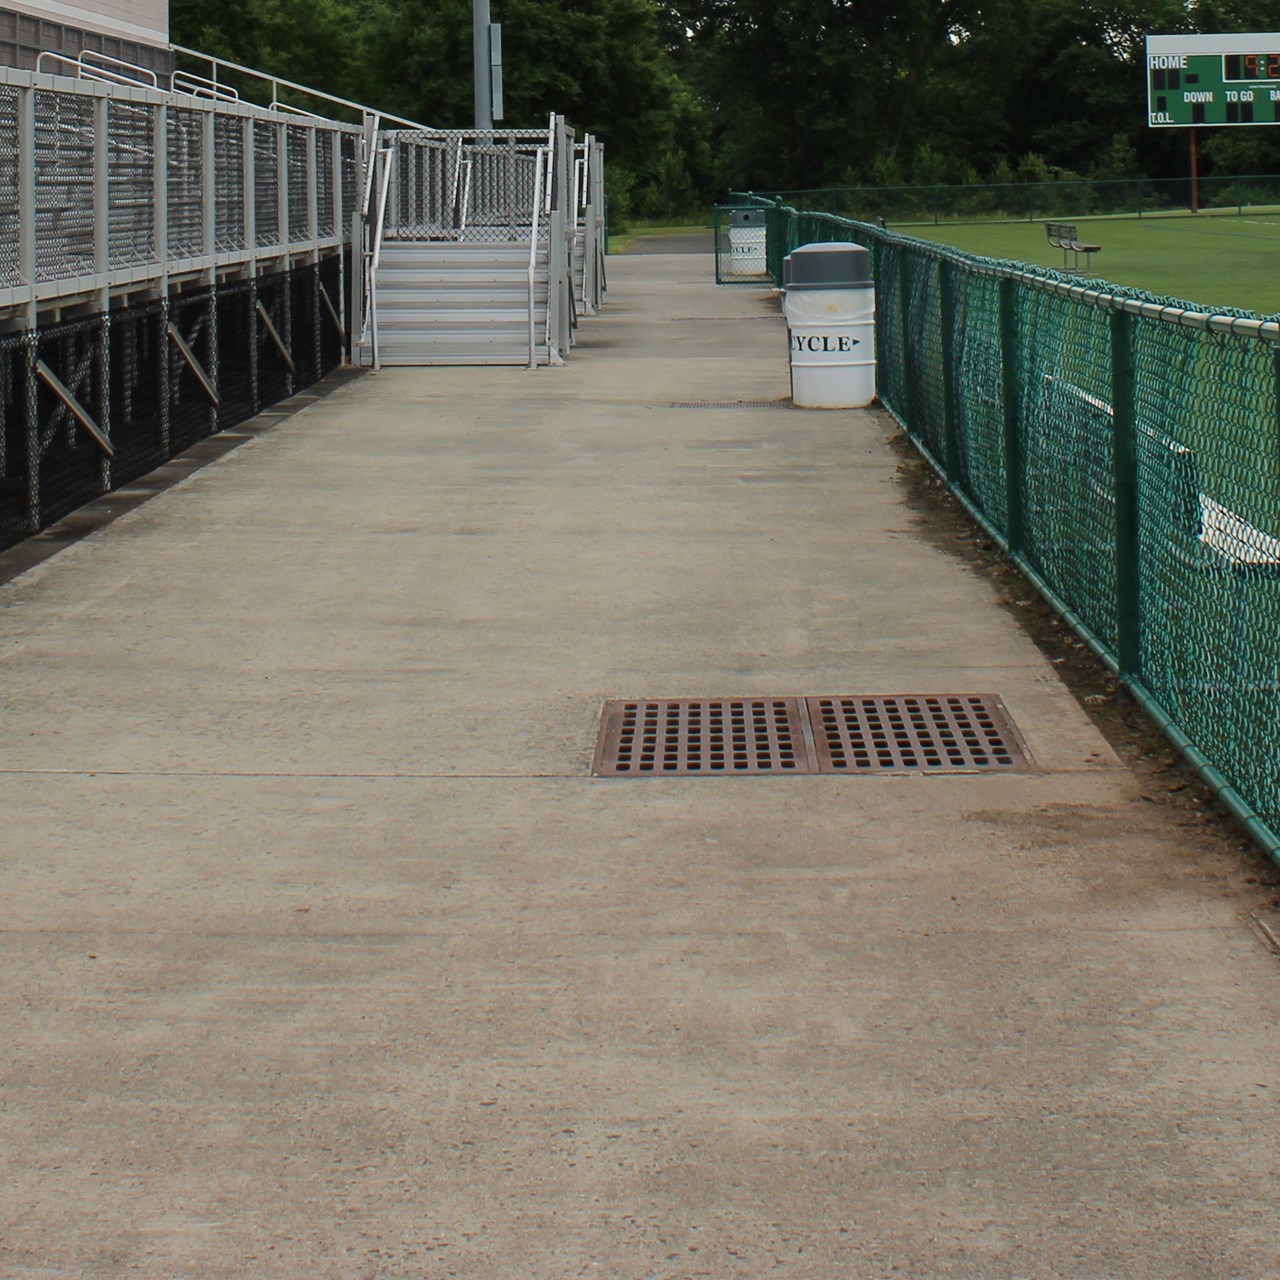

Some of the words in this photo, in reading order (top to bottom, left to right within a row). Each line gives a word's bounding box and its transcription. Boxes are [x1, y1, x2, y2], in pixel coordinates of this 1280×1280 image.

[1150, 55, 1188, 70] HOME
[1184, 91, 1213, 103] DOWN
[1225, 91, 1238, 102] TO
[1240, 90, 1254, 102] GO
